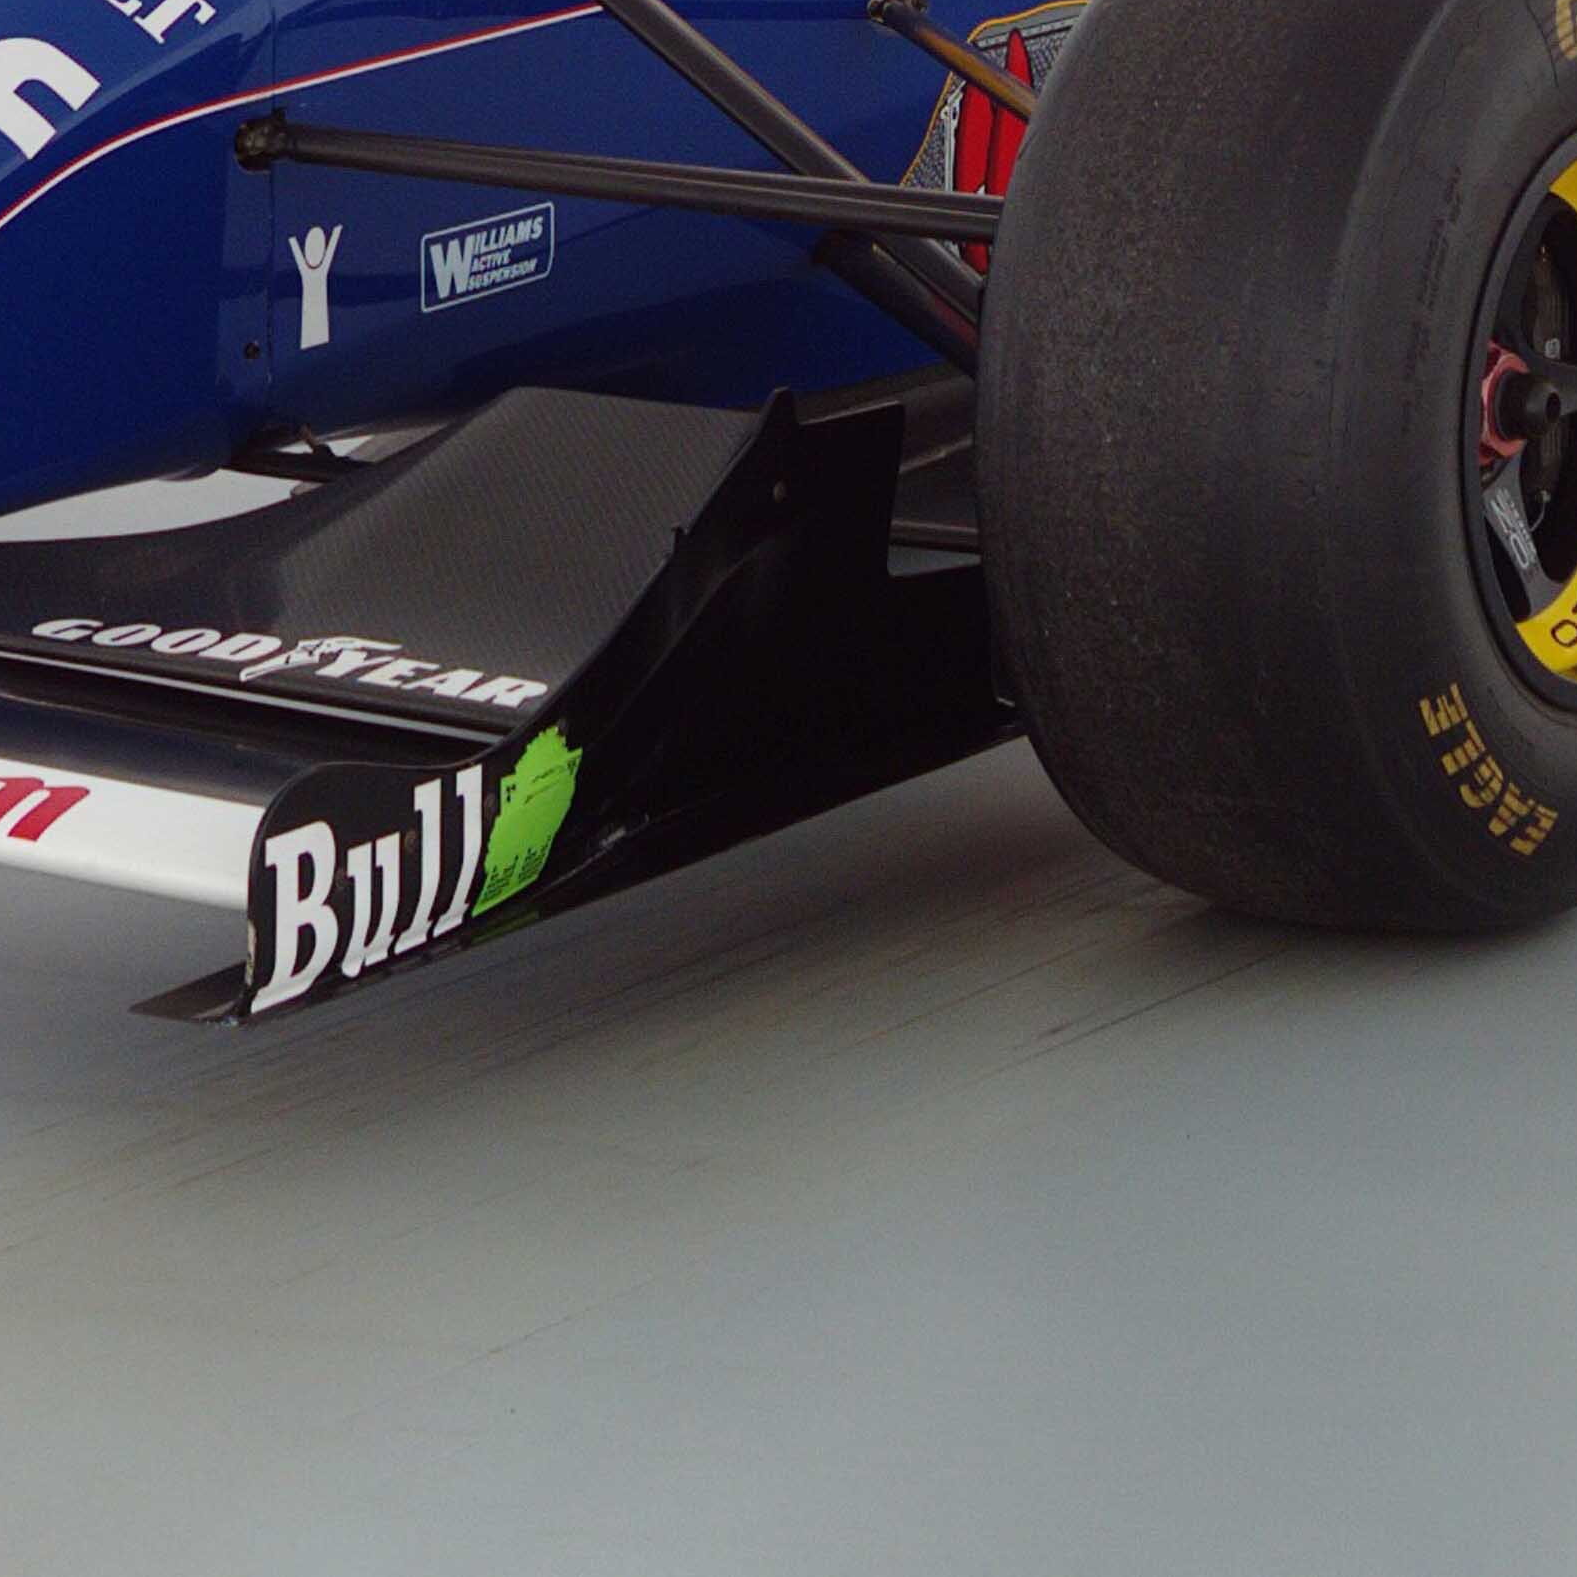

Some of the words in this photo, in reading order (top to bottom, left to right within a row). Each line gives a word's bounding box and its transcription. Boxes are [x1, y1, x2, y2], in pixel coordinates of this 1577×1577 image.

[429, 216, 544, 299] WILLIAMS
[32, 619, 548, 708] GOODYEAR
[1420, 683, 1559, 856] EAGLE
[251, 764, 483, 1014] Bull
